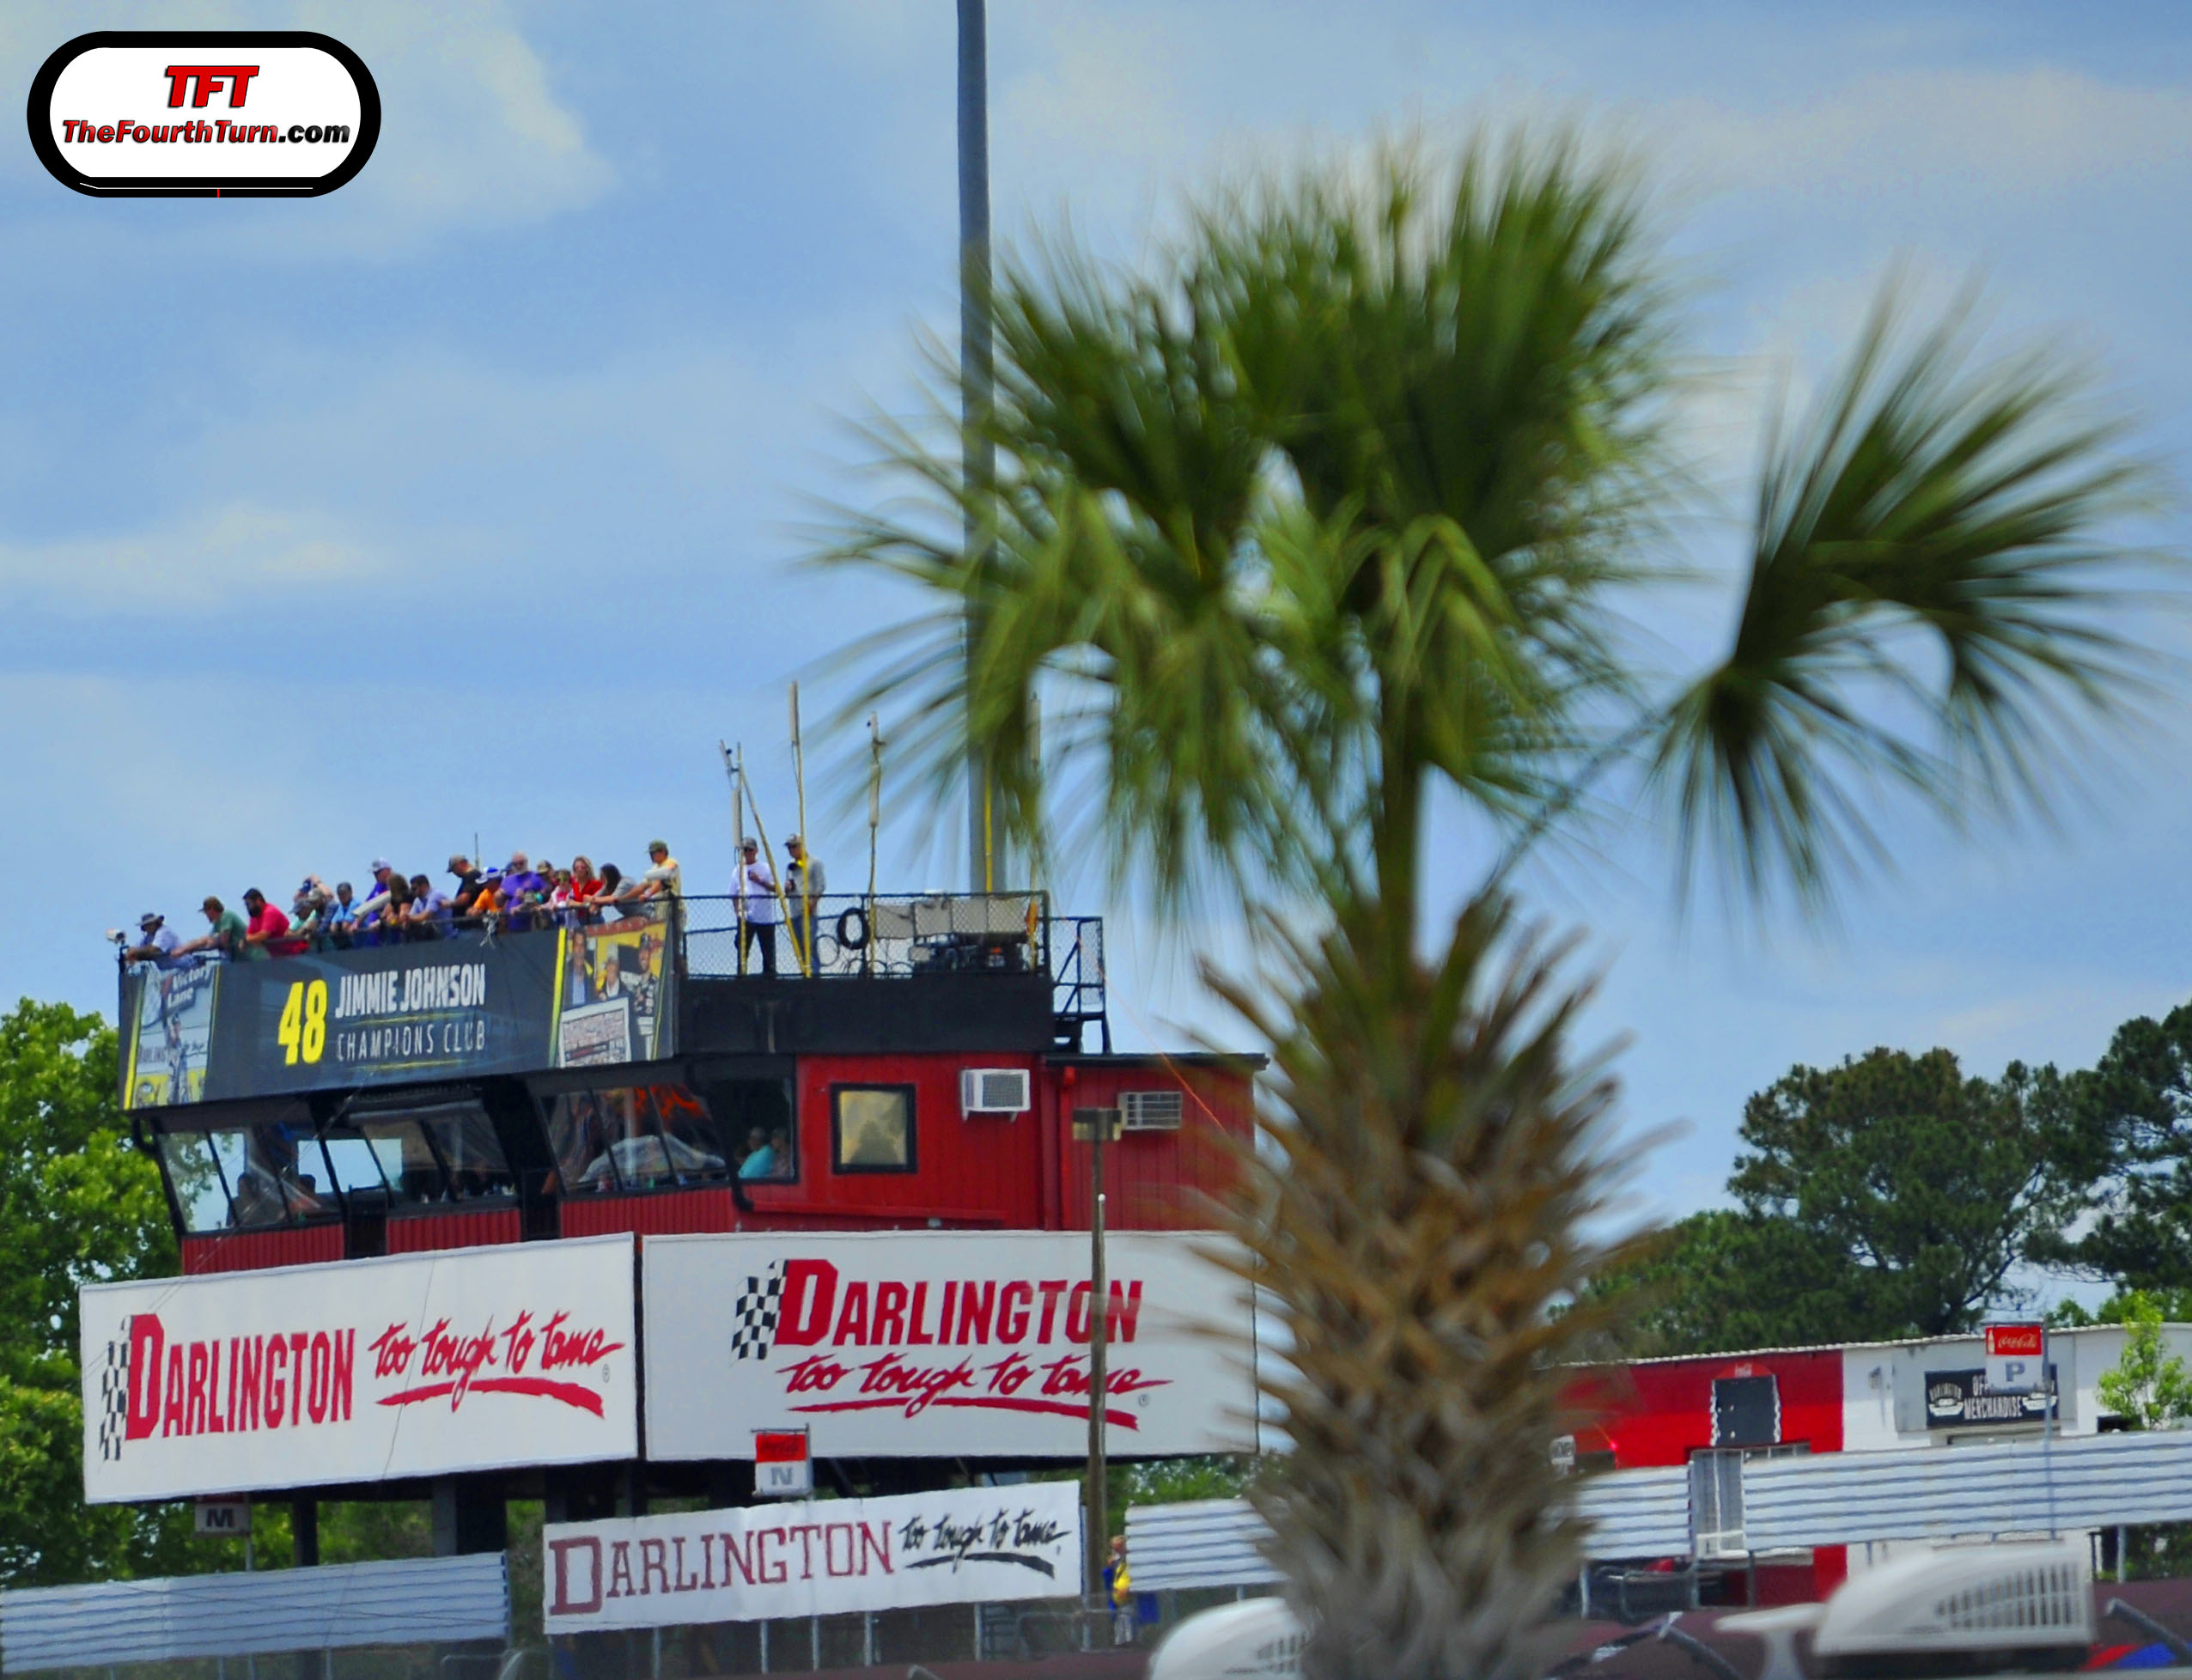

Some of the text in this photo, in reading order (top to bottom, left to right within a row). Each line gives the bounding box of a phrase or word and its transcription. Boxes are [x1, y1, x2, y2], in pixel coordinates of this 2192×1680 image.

[167, 988, 194, 1009] Lane
[334, 963, 486, 1019] JIMMIE JOHNSON
[277, 980, 327, 1066] 48
[337, 1020, 486, 1062] CHAMPIONS CLUB
[775, 1258, 1143, 1346] DARLINGTON
[125, 1313, 356, 1440] DARLINGTON
[2006, 1362, 2025, 1382] P
[1964, 1396, 2023, 1420] MERCHANDISE
[771, 1466, 793, 1486] N
[206, 1508, 234, 1528] M
[549, 1521, 895, 1616] DARLINGTON
